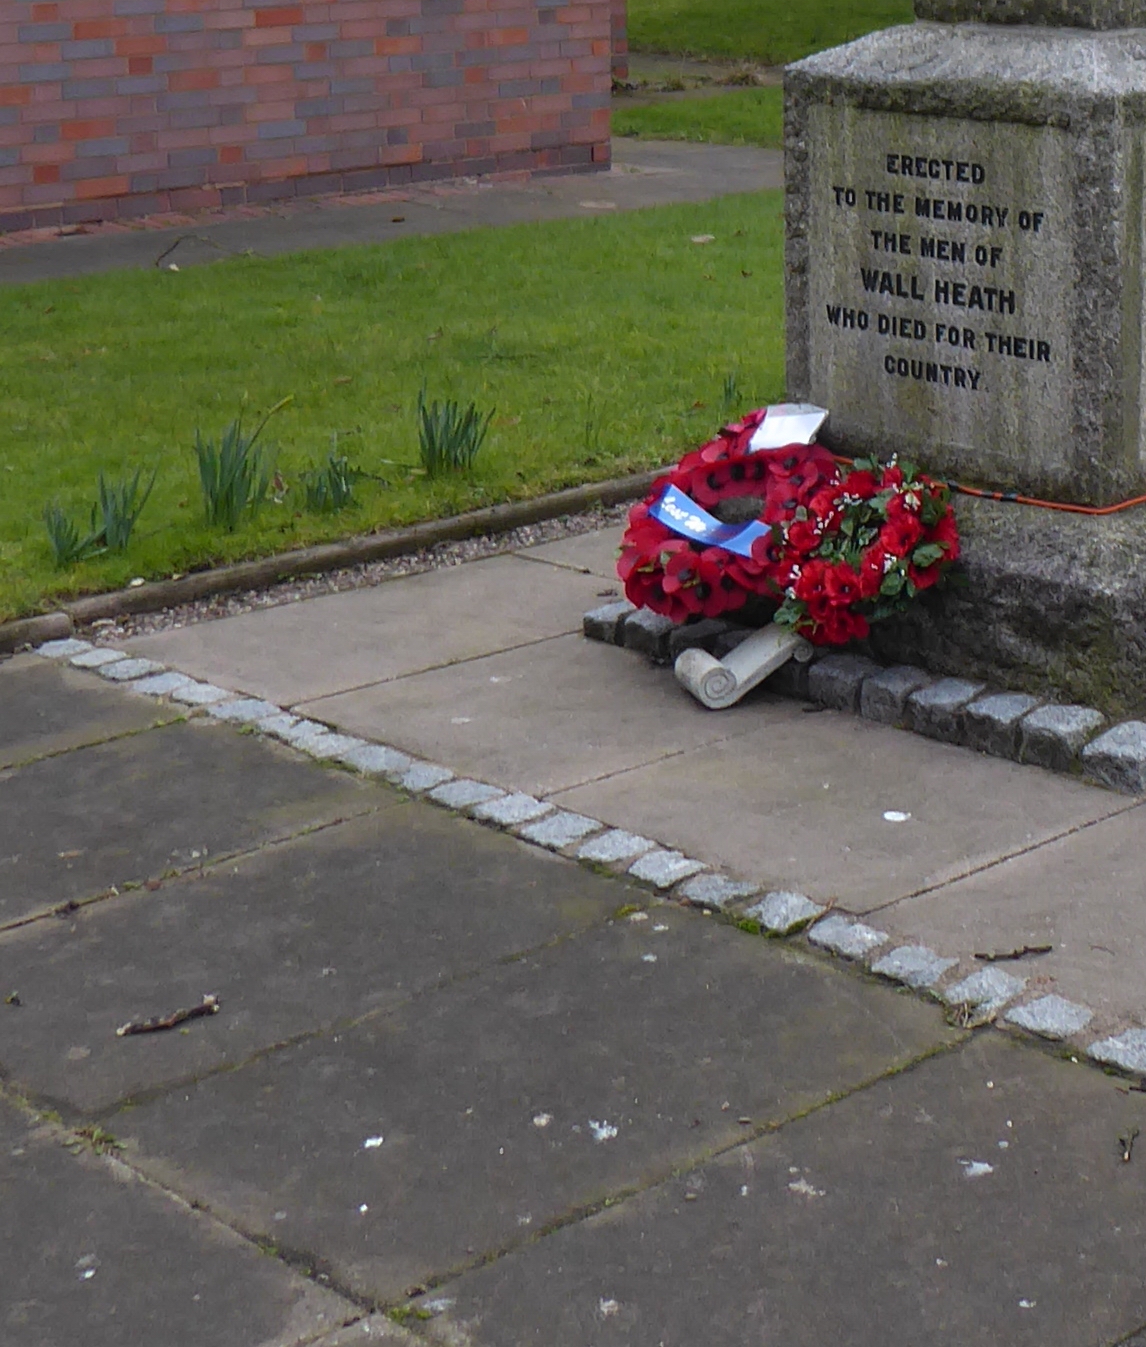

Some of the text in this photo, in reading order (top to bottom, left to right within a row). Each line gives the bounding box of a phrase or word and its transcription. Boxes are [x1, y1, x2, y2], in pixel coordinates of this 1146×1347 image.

[886, 154, 986, 184] ERECTED
[833, 185, 1044, 232] TO THE MEMORY OF
[871, 229, 1003, 269] THE MEN OF
[860, 267, 1016, 315] WALL HEATH
[826, 304, 1051, 362] WHO DIED FOR THEIR
[884, 355, 982, 391] COUNTRY
